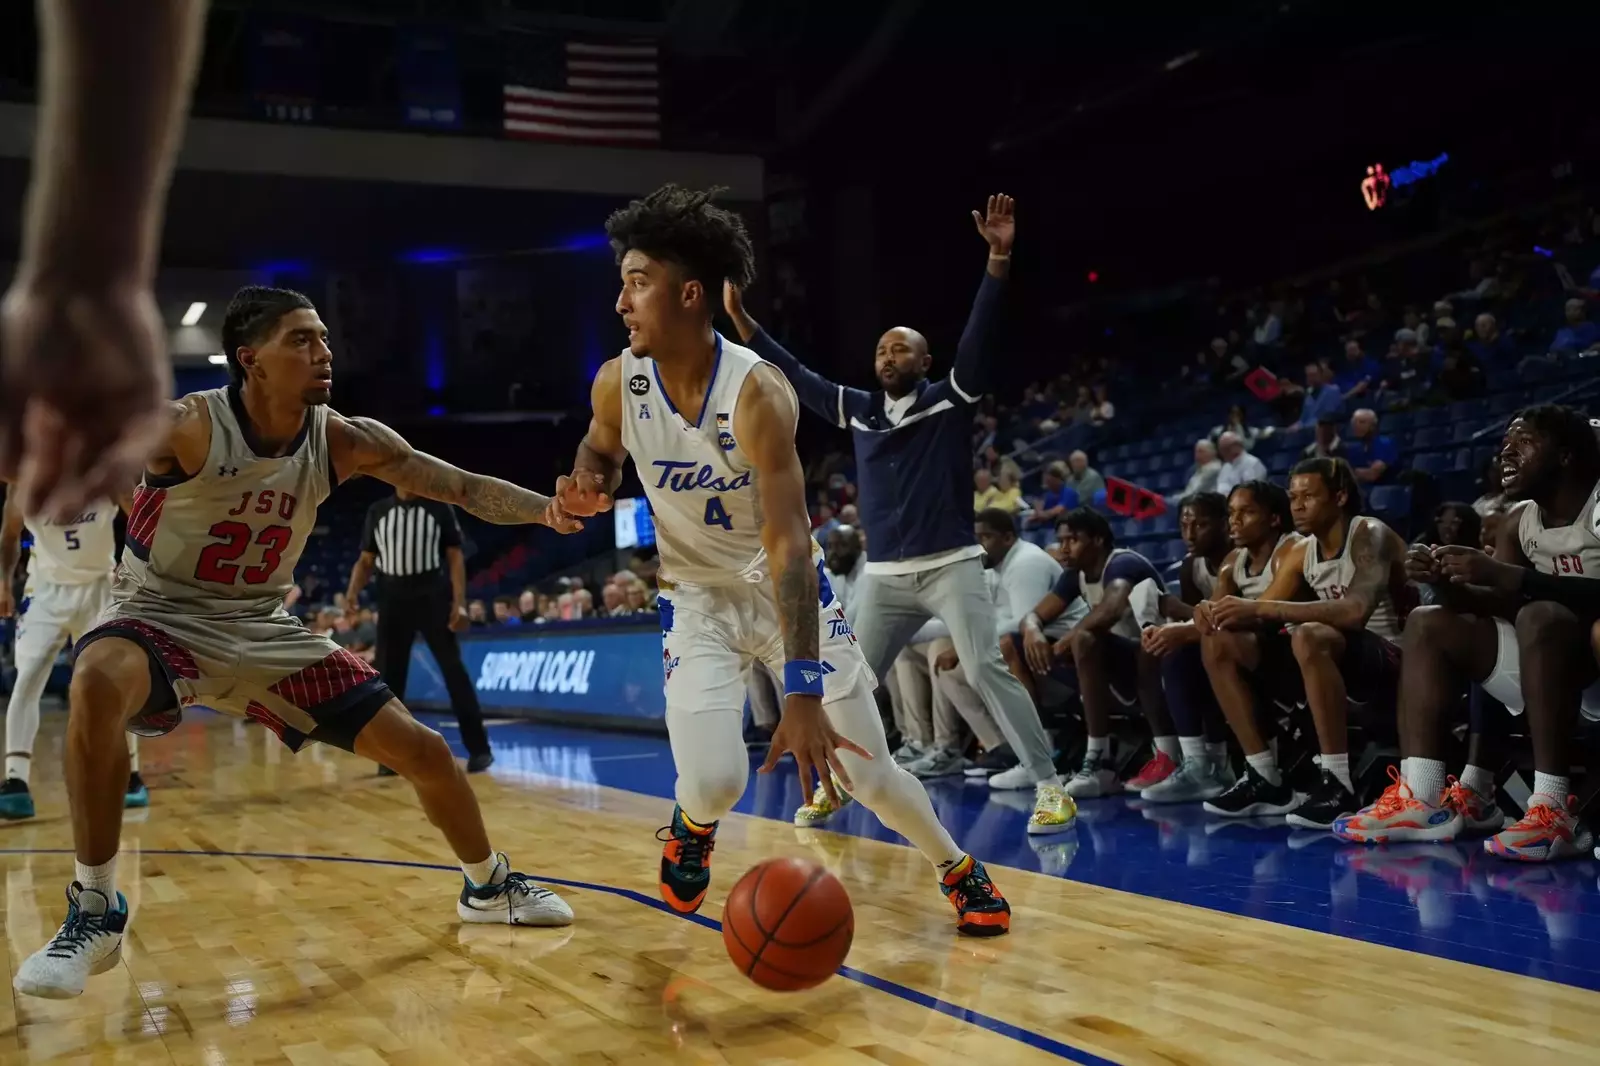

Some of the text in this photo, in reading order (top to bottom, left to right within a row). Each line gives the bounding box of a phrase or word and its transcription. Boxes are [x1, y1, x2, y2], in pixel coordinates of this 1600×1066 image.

[630, 379, 648, 391] 32
[652, 460, 751, 492] Tulsa
[228, 489, 298, 521] JSU
[704, 495, 734, 531] 4
[64, 529, 81, 550] 5
[193, 520, 293, 586] 23
[476, 650, 595, 694] SUPPORT LOCAL
